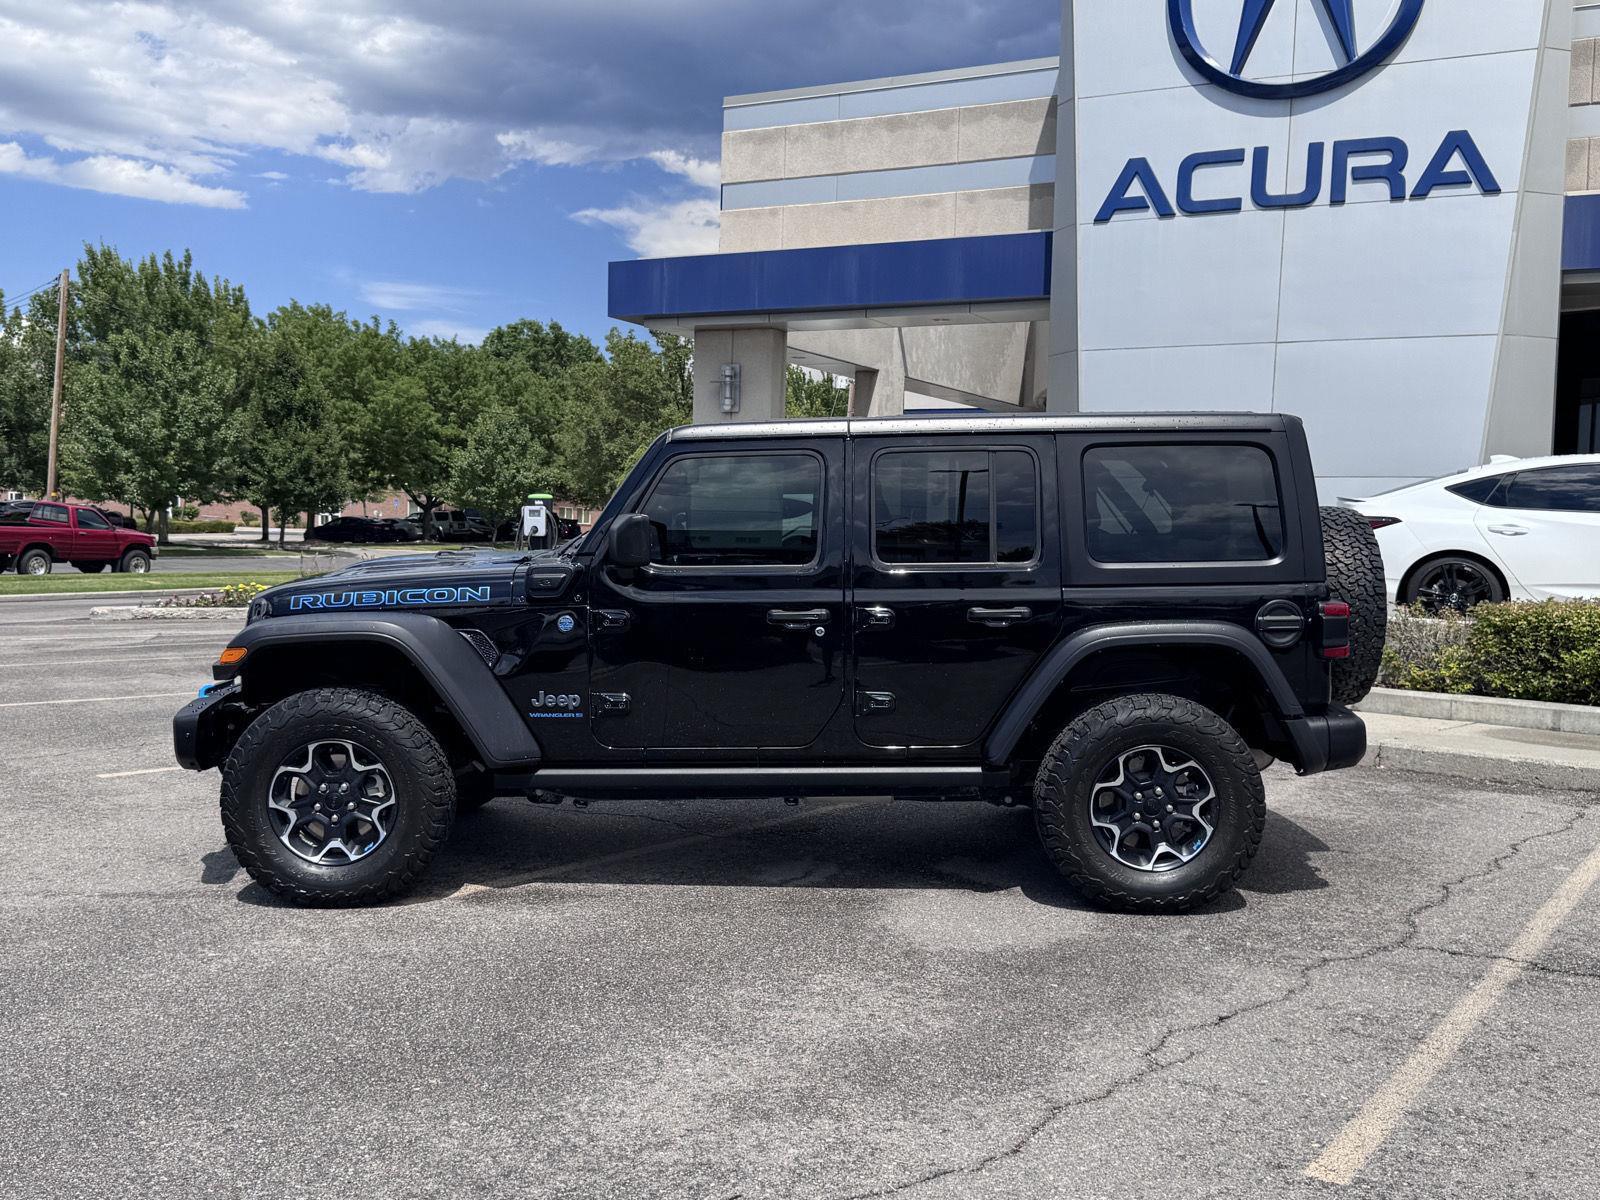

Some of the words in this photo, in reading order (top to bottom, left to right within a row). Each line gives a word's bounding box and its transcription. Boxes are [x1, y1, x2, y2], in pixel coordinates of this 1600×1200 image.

[1094, 129, 1501, 225] ACURA
[290, 586, 491, 610] RUBICON
[531, 690, 581, 710] Jeep
